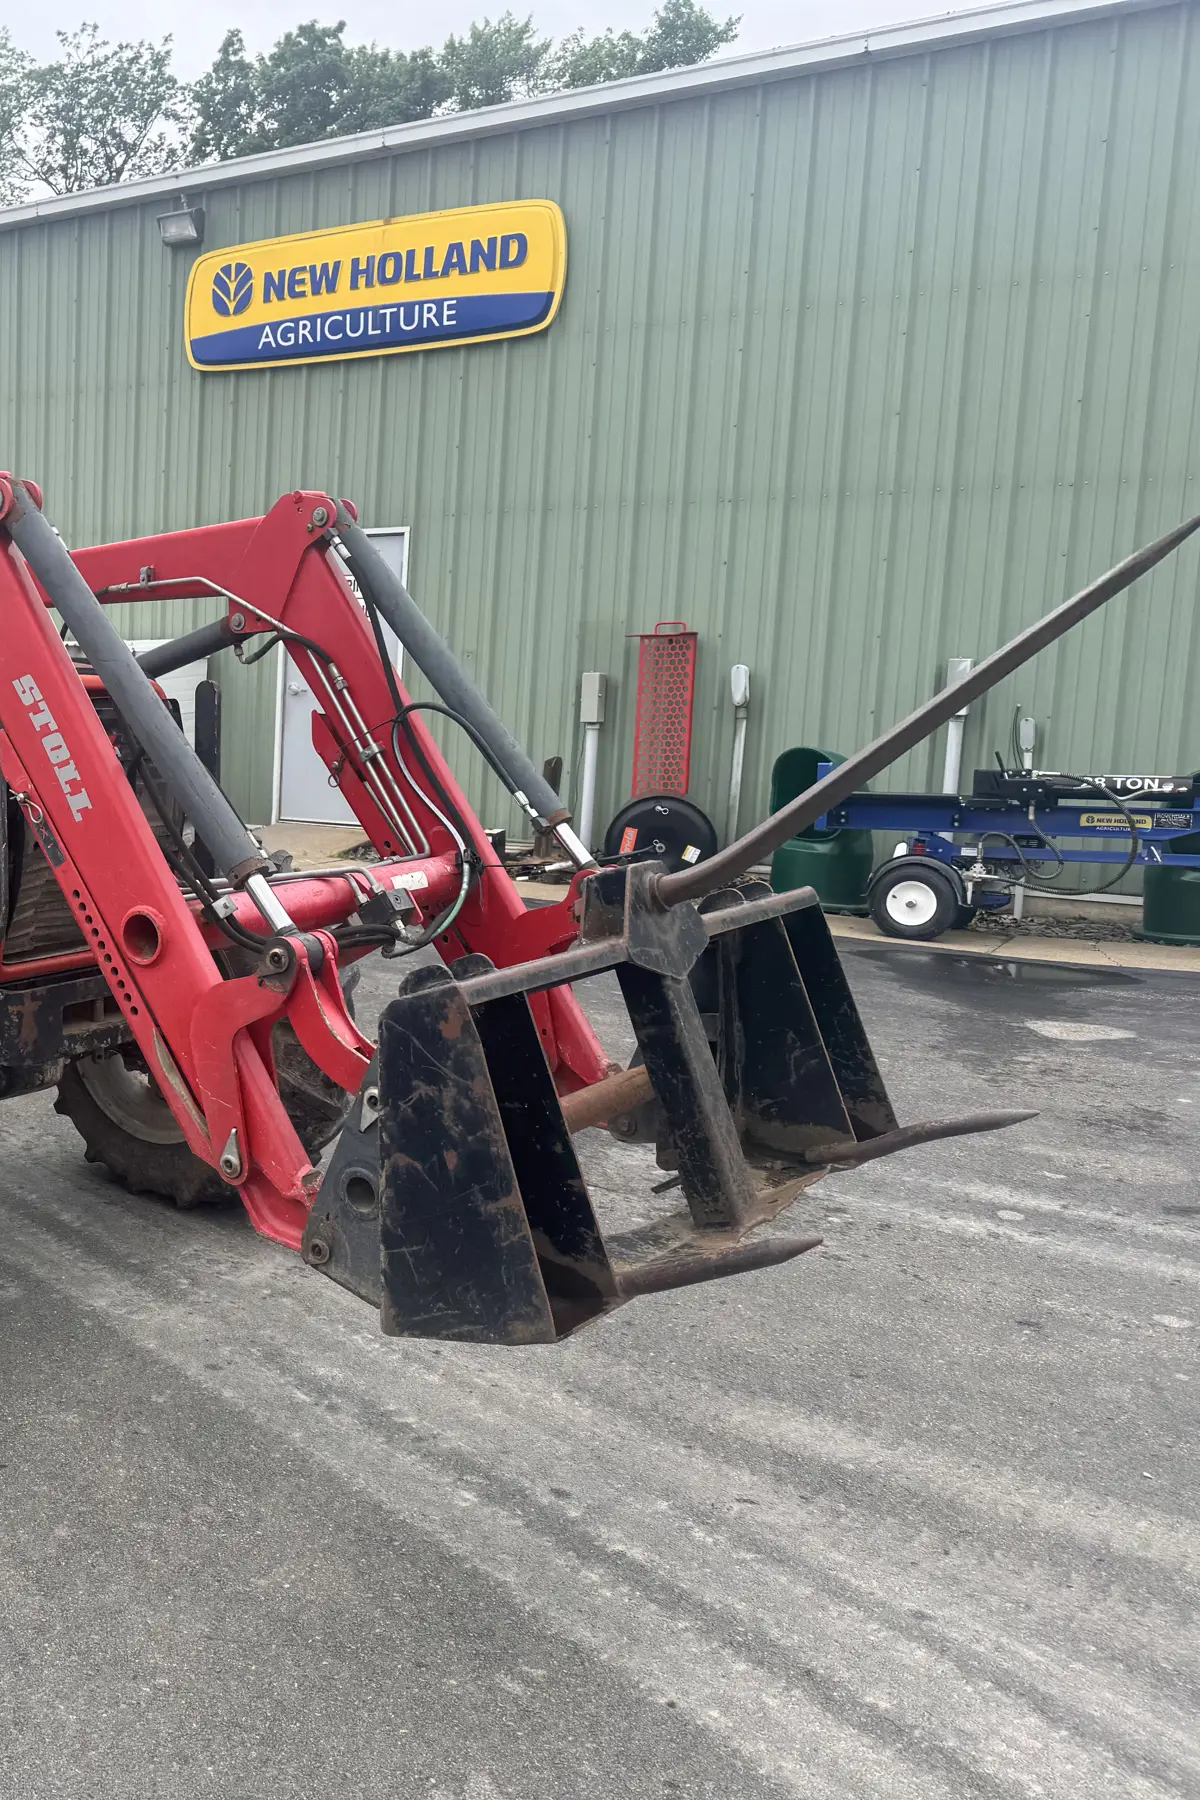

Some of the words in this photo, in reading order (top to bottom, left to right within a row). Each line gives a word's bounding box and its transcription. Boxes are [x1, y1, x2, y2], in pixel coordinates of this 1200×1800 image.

[262, 259, 342, 304] NEW
[349, 232, 529, 291] HOLLAND
[257, 299, 458, 350] AGRICULTURE
[11, 673, 93, 823] STOLL
[1112, 777, 1160, 790] TON
[1113, 818, 1147, 826] HOLND
